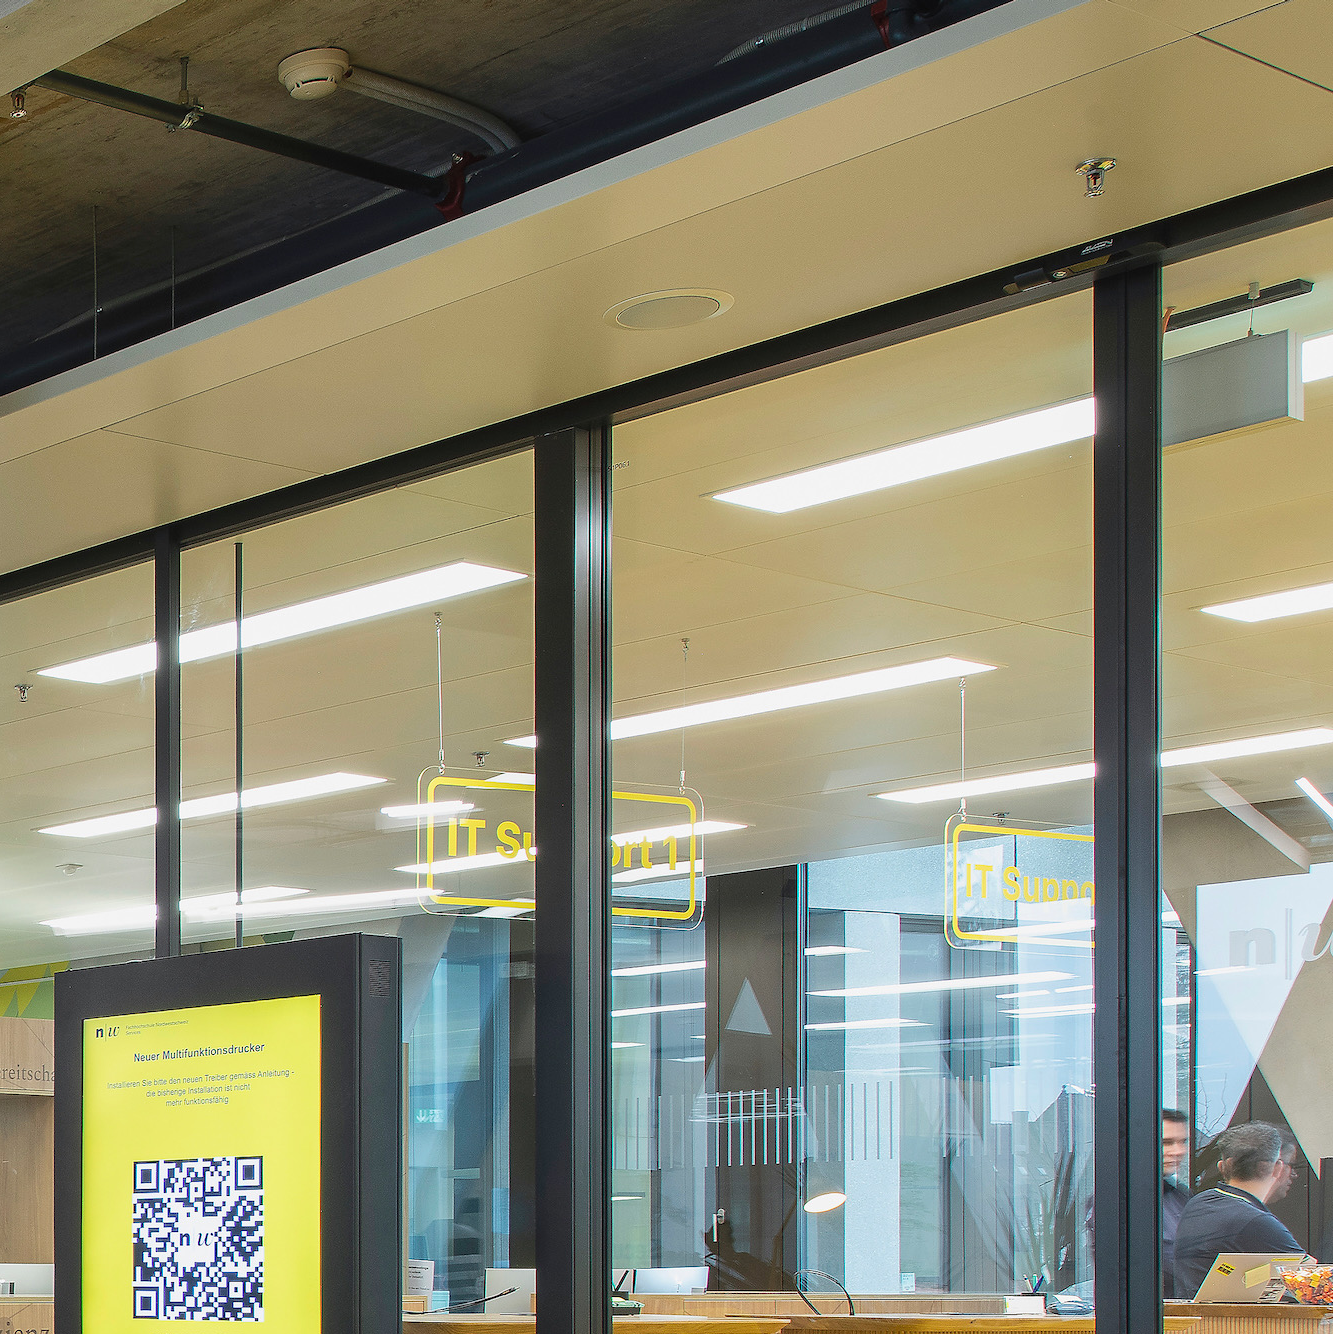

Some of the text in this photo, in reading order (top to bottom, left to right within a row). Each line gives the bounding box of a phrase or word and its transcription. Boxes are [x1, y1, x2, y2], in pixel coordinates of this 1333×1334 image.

[448, 818, 485, 857] IT
[663, 835, 677, 870] 1
[966, 863, 993, 898] IT
[133, 1043, 265, 1062] Neuer Multifunktionsdrucker
[106, 1080, 141, 1089] Installieren
[141, 1079, 153, 1087] Sie
[168, 1077, 182, 1085] den
[182, 1075, 203, 1083] neuen
[204, 1073, 228, 1082] Treiber
[257, 1068, 290, 1078] Anleitung
[187, 1084, 223, 1095] Installation
[224, 1083, 233, 1092] ist
[233, 1082, 251, 1091] nicht
[183, 1096, 229, 1106] funktionsfähig
